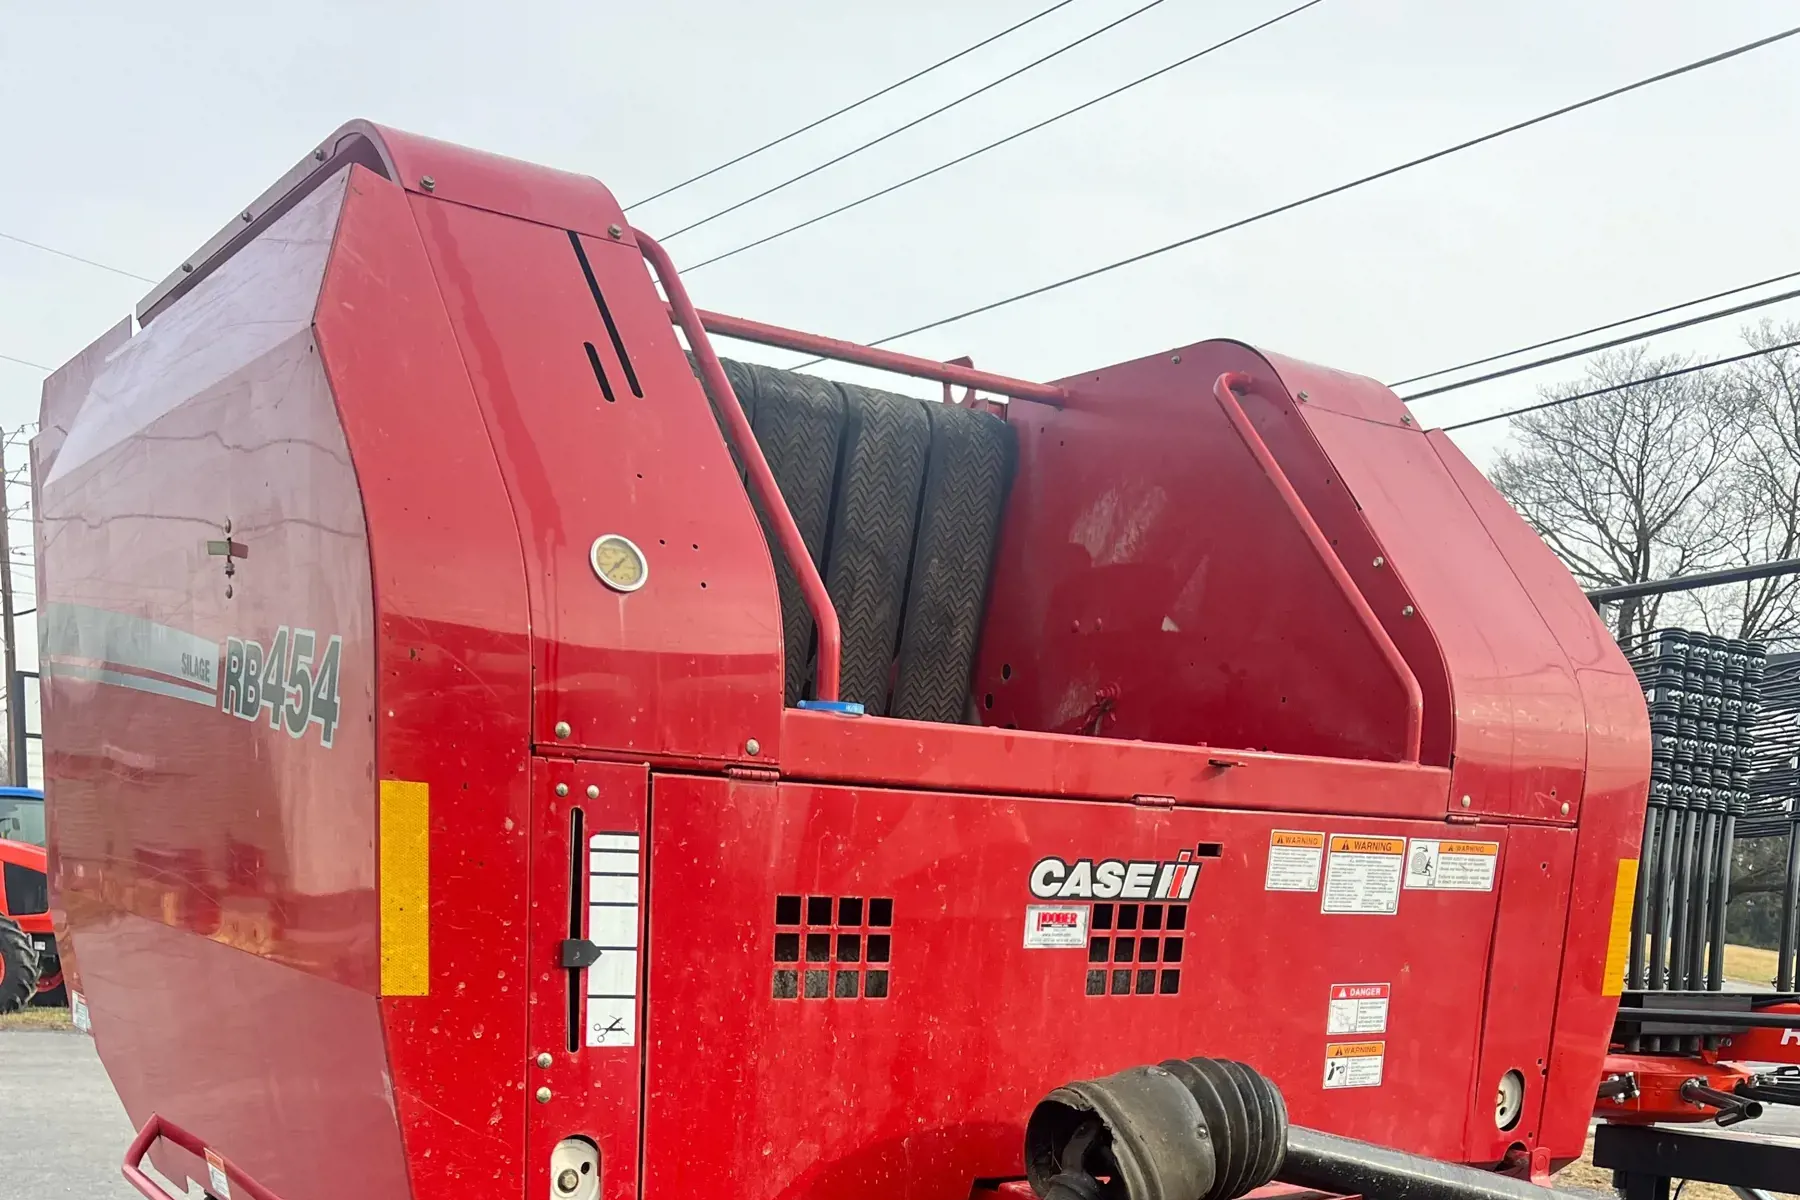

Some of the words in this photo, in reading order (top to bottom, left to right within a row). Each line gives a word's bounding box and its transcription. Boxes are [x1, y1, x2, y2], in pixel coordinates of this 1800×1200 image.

[181, 651, 211, 684] SILAGE
[222, 625, 343, 749] RB454
[1285, 835, 1319, 846] WARNING
[1353, 840, 1392, 852] WARNING
[1455, 845, 1485, 853] WARNING
[1030, 858, 1157, 899] CASE
[1349, 987, 1382, 997] DANGER
[1343, 1045, 1378, 1055] WARNING
